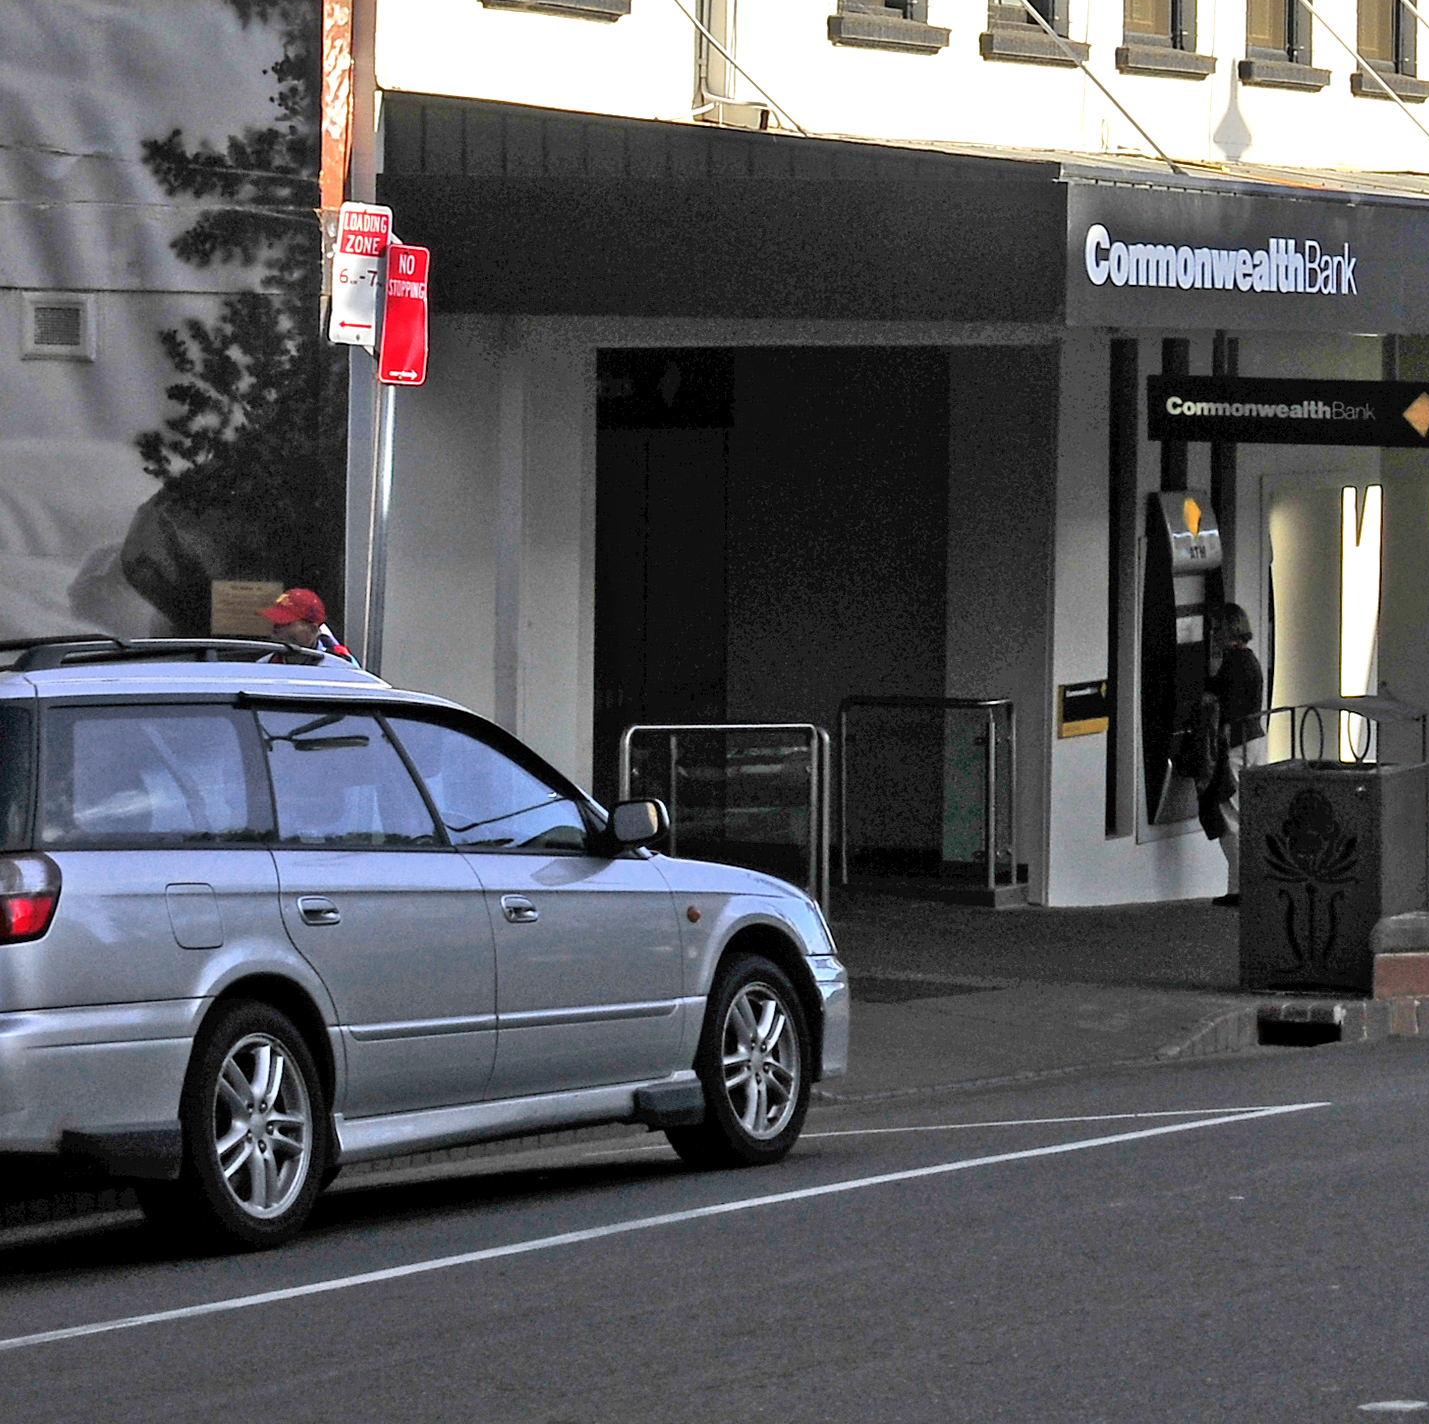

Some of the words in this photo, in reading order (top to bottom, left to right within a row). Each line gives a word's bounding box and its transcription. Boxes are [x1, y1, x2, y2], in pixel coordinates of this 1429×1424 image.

[344, 213, 387, 234] LOADING
[346, 235, 380, 254] ZONE
[398, 253, 416, 275] NO
[1086, 223, 1358, 295] CommonwealthBank
[388, 279, 424, 299] STOPPING
[1166, 395, 1376, 421] CommonwealthBank
